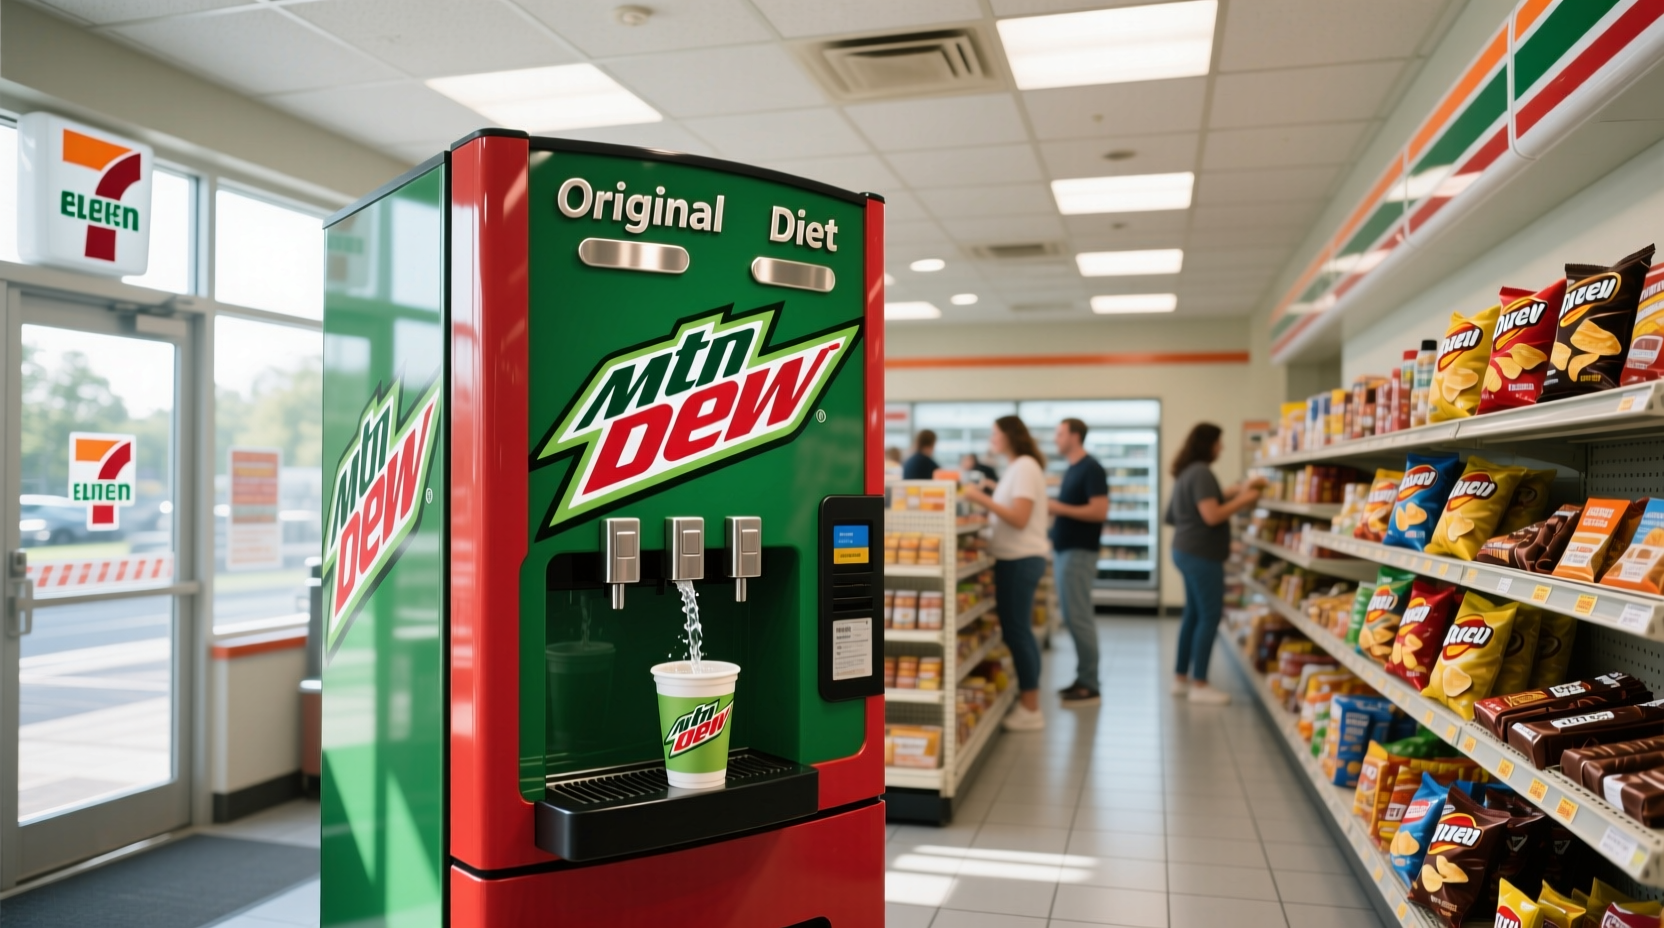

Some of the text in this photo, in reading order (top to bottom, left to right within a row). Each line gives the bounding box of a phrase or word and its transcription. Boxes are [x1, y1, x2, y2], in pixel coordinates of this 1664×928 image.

[557, 177, 725, 234] Original
[769, 205, 838, 252] Diet
[573, 328, 756, 433] Mtn
[330, 404, 392, 551] Mtn
